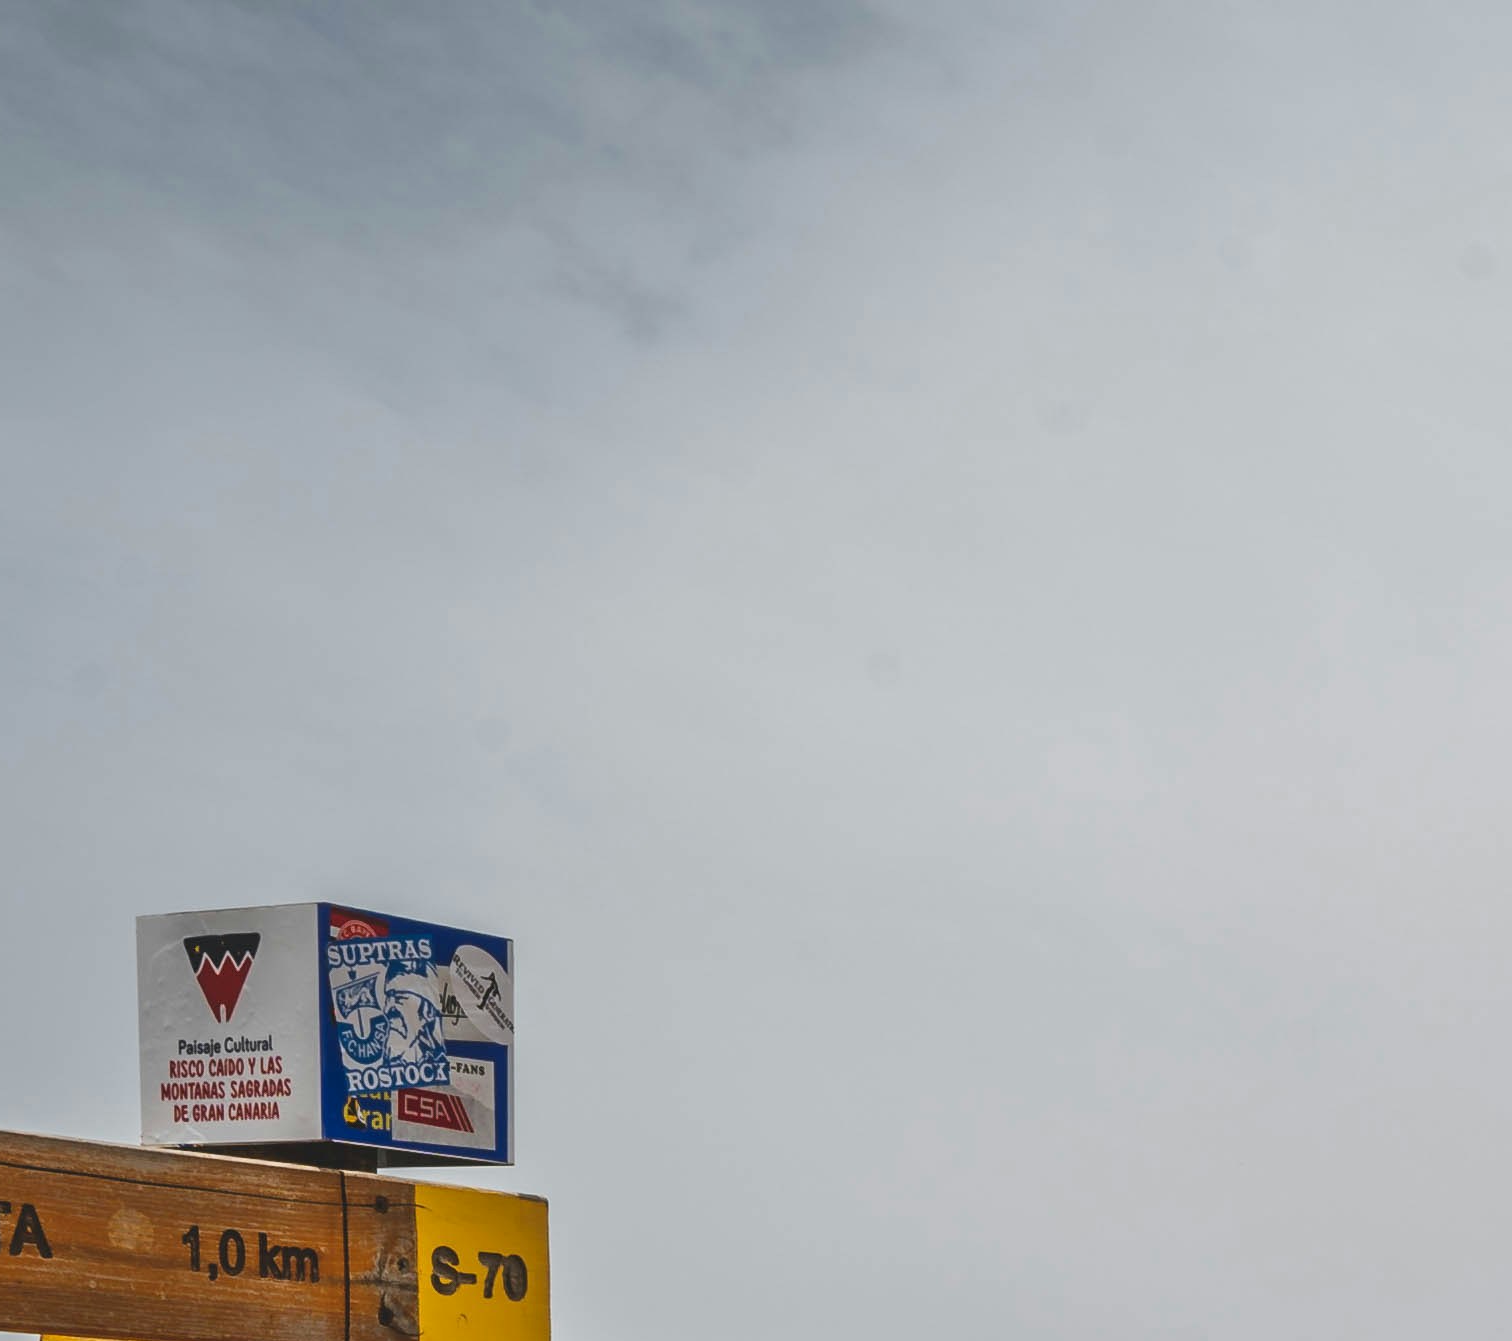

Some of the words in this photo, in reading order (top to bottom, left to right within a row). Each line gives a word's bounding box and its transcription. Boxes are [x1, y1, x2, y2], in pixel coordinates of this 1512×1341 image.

[328, 939, 432, 966] SUPTRAS
[178, 1039, 221, 1057] Paisaje
[224, 1035, 273, 1053] Cultural
[358, 1022, 388, 1058] HANSA
[169, 1060, 204, 1078] RISCO
[248, 1058, 256, 1075] Y
[260, 1056, 283, 1075] LAS
[346, 1062, 450, 1092] ROSTOCK
[161, 1081, 225, 1101] MONTAÑAS
[230, 1078, 291, 1098] SAGRADAS
[174, 1104, 189, 1122] DE
[192, 1103, 224, 1121] GRAN
[228, 1101, 280, 1120] CANARIA
[404, 1094, 451, 1122] CSA
[182, 1225, 245, 1281] 1,0
[258, 1232, 320, 1283] km
[430, 1245, 528, 1302] S-70
